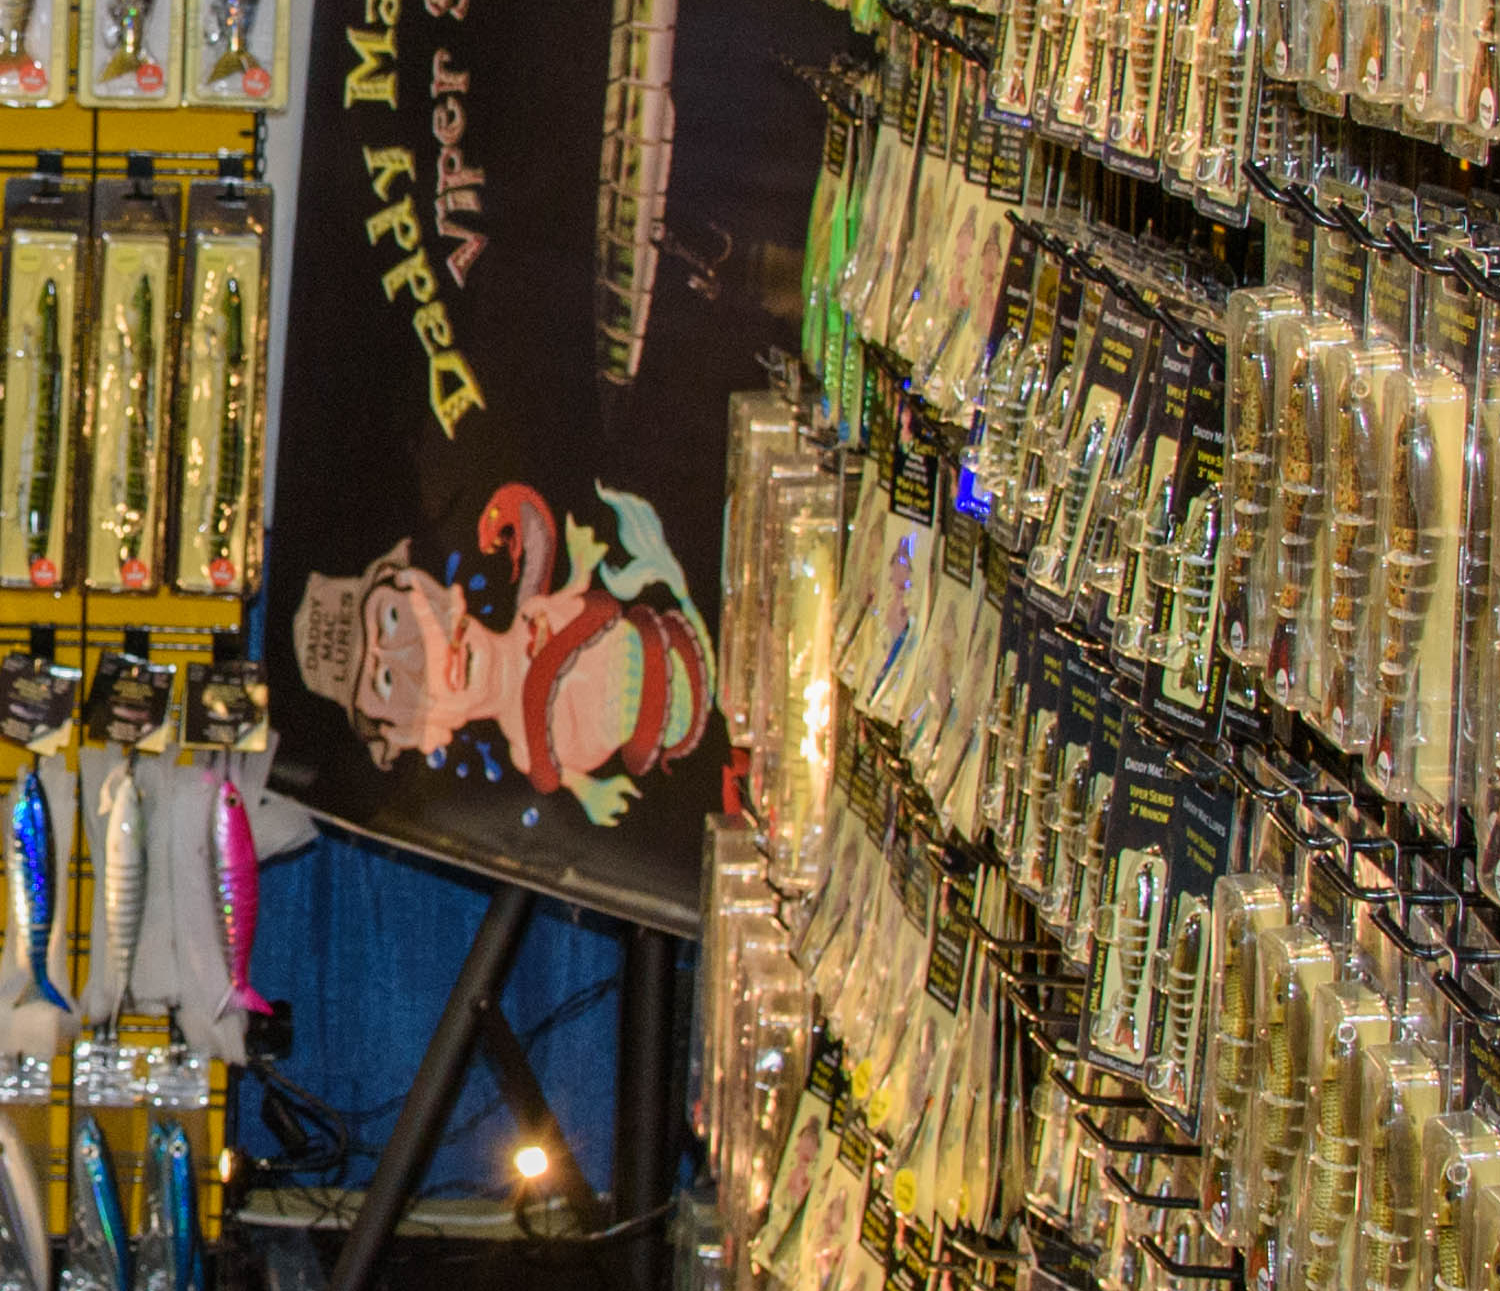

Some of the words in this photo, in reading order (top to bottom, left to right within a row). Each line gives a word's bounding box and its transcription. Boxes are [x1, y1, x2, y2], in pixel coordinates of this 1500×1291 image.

[430, 47, 489, 291] Viper
[363, 144, 487, 441] Daddy
[1124, 756, 1147, 774] DADDY
[1147, 763, 1164, 780] MAC
[1129, 783, 1149, 805] VIPER
[1149, 788, 1175, 809] SERIES
